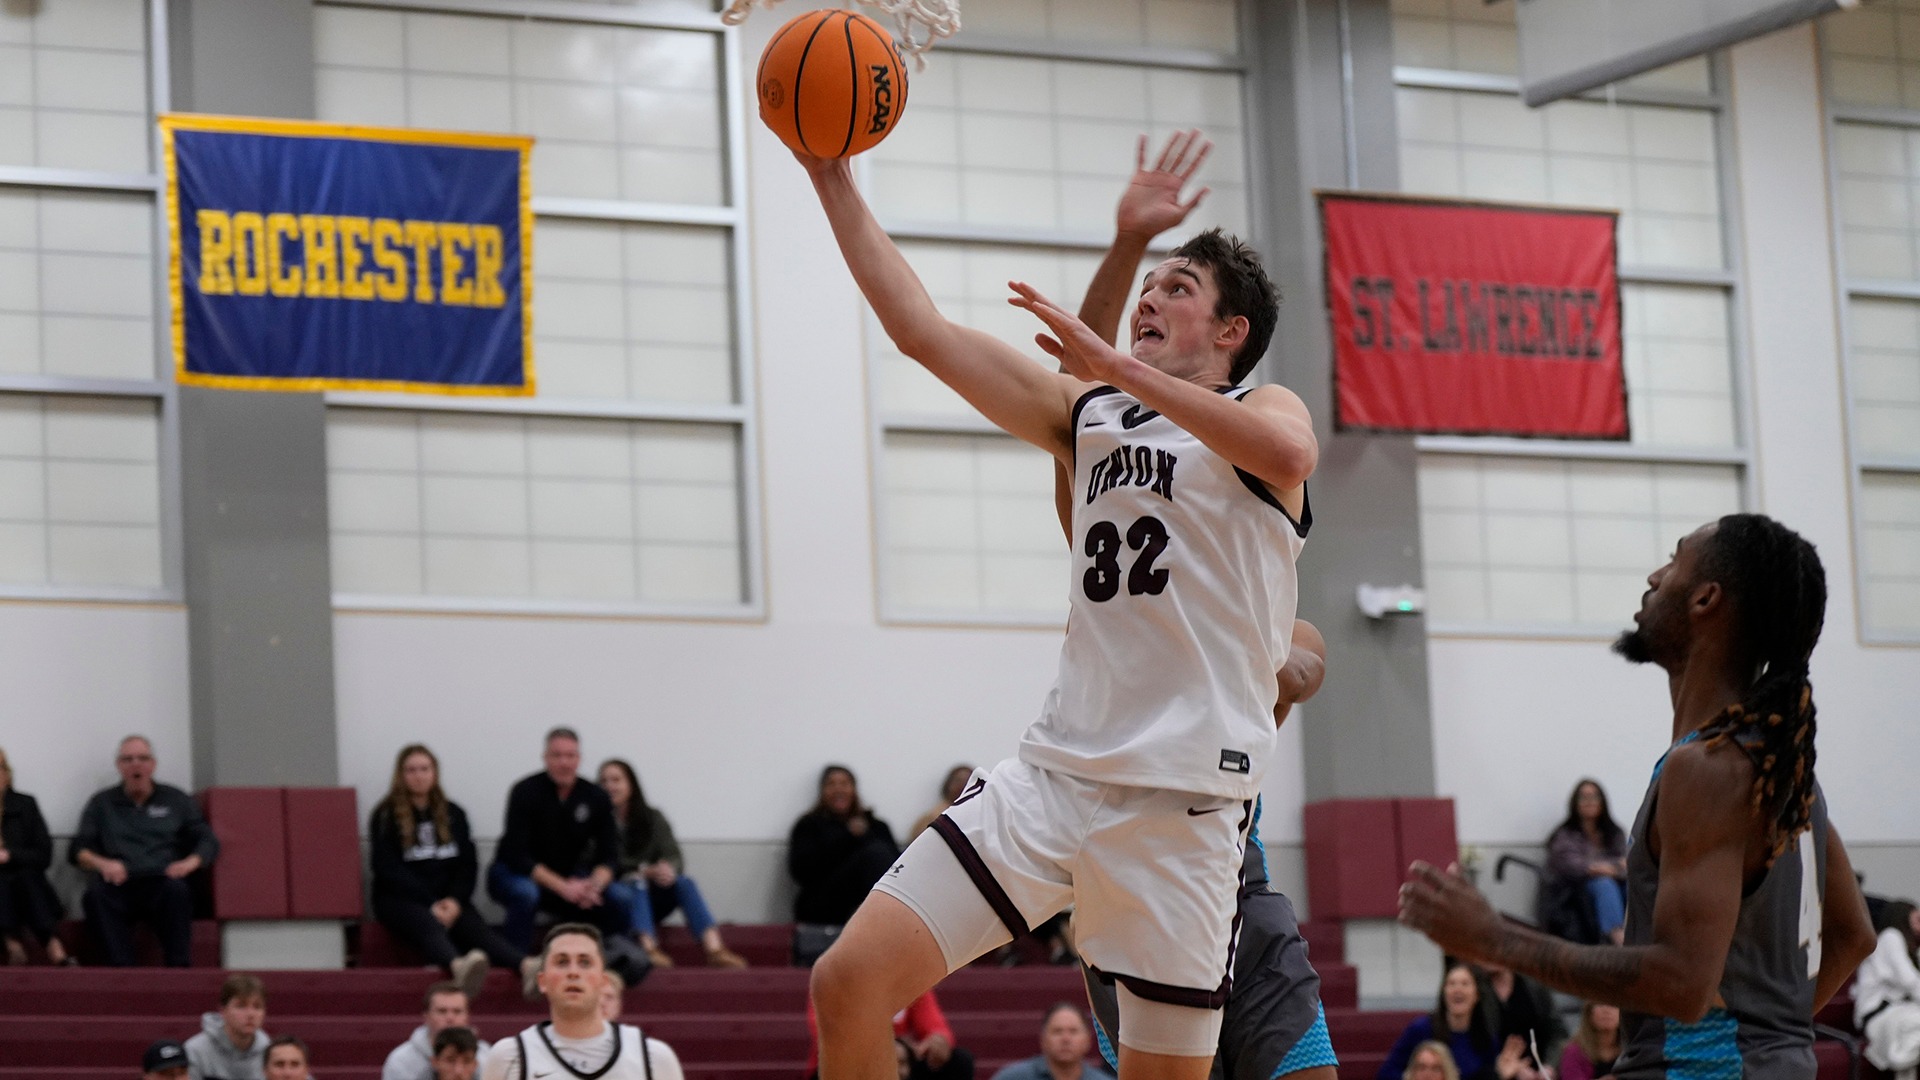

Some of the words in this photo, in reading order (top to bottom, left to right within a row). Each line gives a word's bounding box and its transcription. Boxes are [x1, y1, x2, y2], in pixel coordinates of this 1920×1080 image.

[869, 65, 891, 135] NCAA
[196, 209, 506, 309] ROCHESTER
[1353, 276, 1410, 351] ST.
[1417, 278, 1604, 361] LAWRENCE
[1086, 444, 1178, 505] UNION
[1083, 515, 1171, 603] 32
